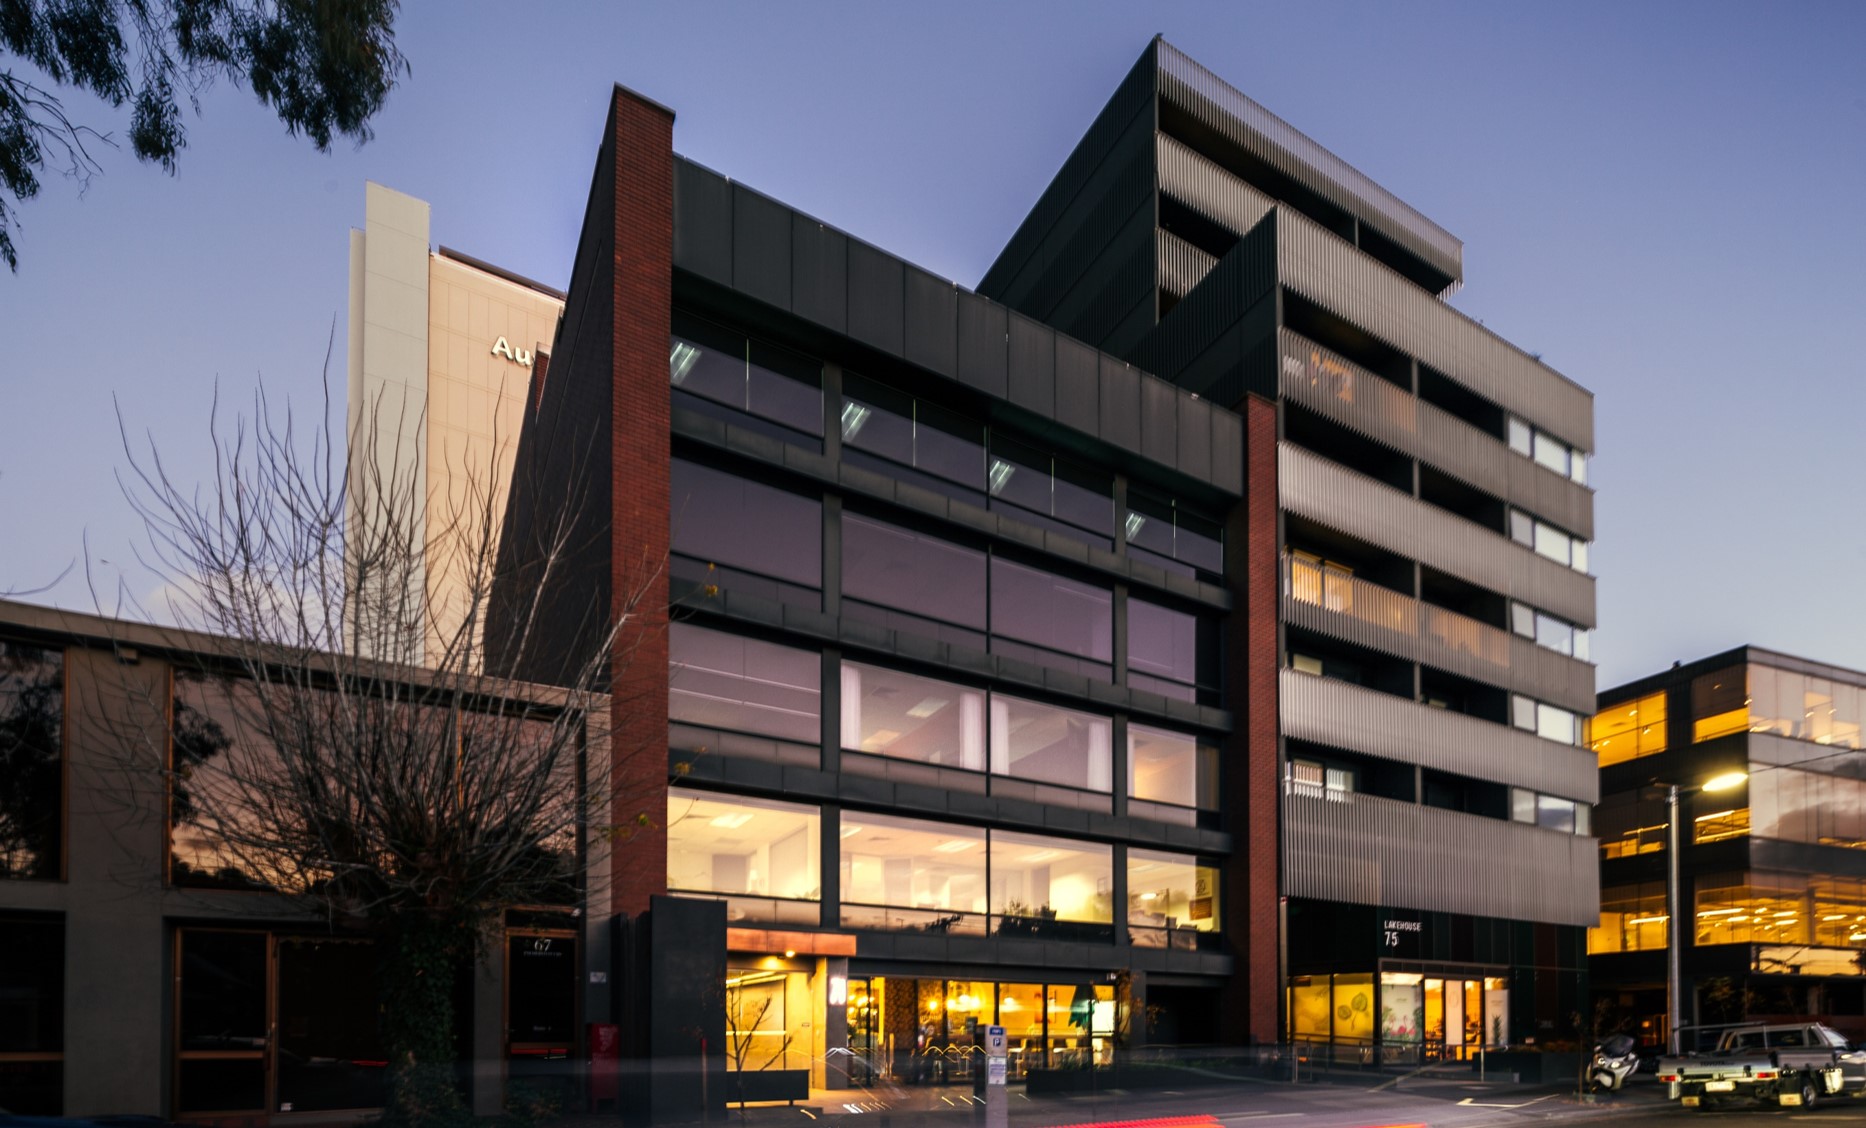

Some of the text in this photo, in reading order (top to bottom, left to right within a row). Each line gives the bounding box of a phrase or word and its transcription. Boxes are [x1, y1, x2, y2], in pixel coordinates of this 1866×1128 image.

[1384, 920, 1421, 932] LAKEHOUSE
[534, 939, 552, 951] 67
[1384, 931, 1399, 947] 75
